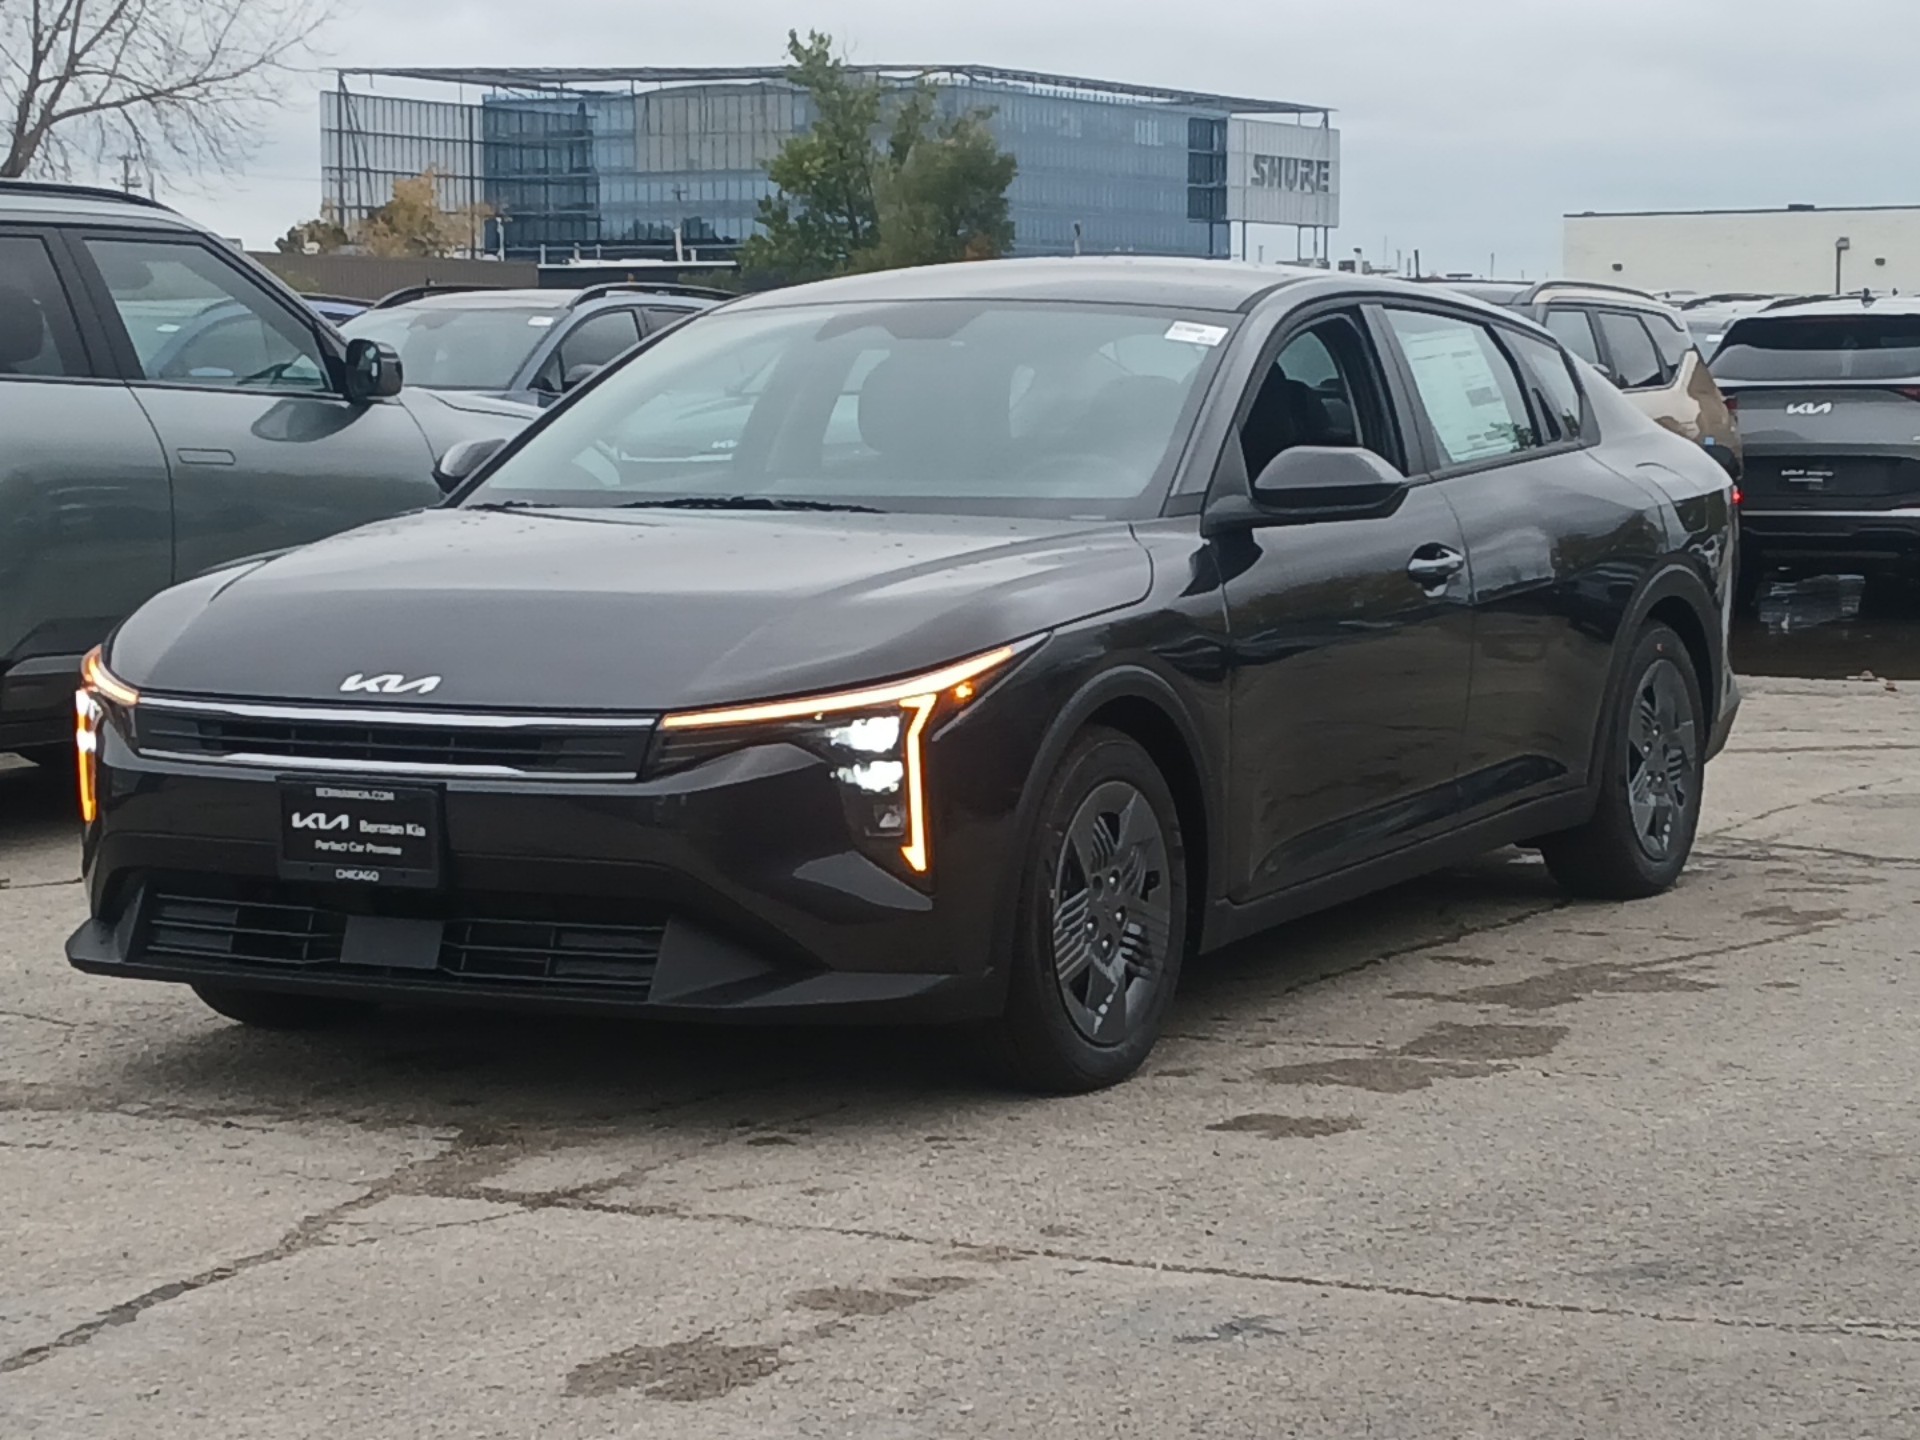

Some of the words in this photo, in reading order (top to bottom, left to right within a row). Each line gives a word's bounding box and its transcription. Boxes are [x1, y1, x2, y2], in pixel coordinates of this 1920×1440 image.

[1250, 153, 1330, 194] SHURE
[1786, 402, 1832, 414] KIA
[340, 673, 442, 694] KIA
[292, 812, 349, 830] KIA
